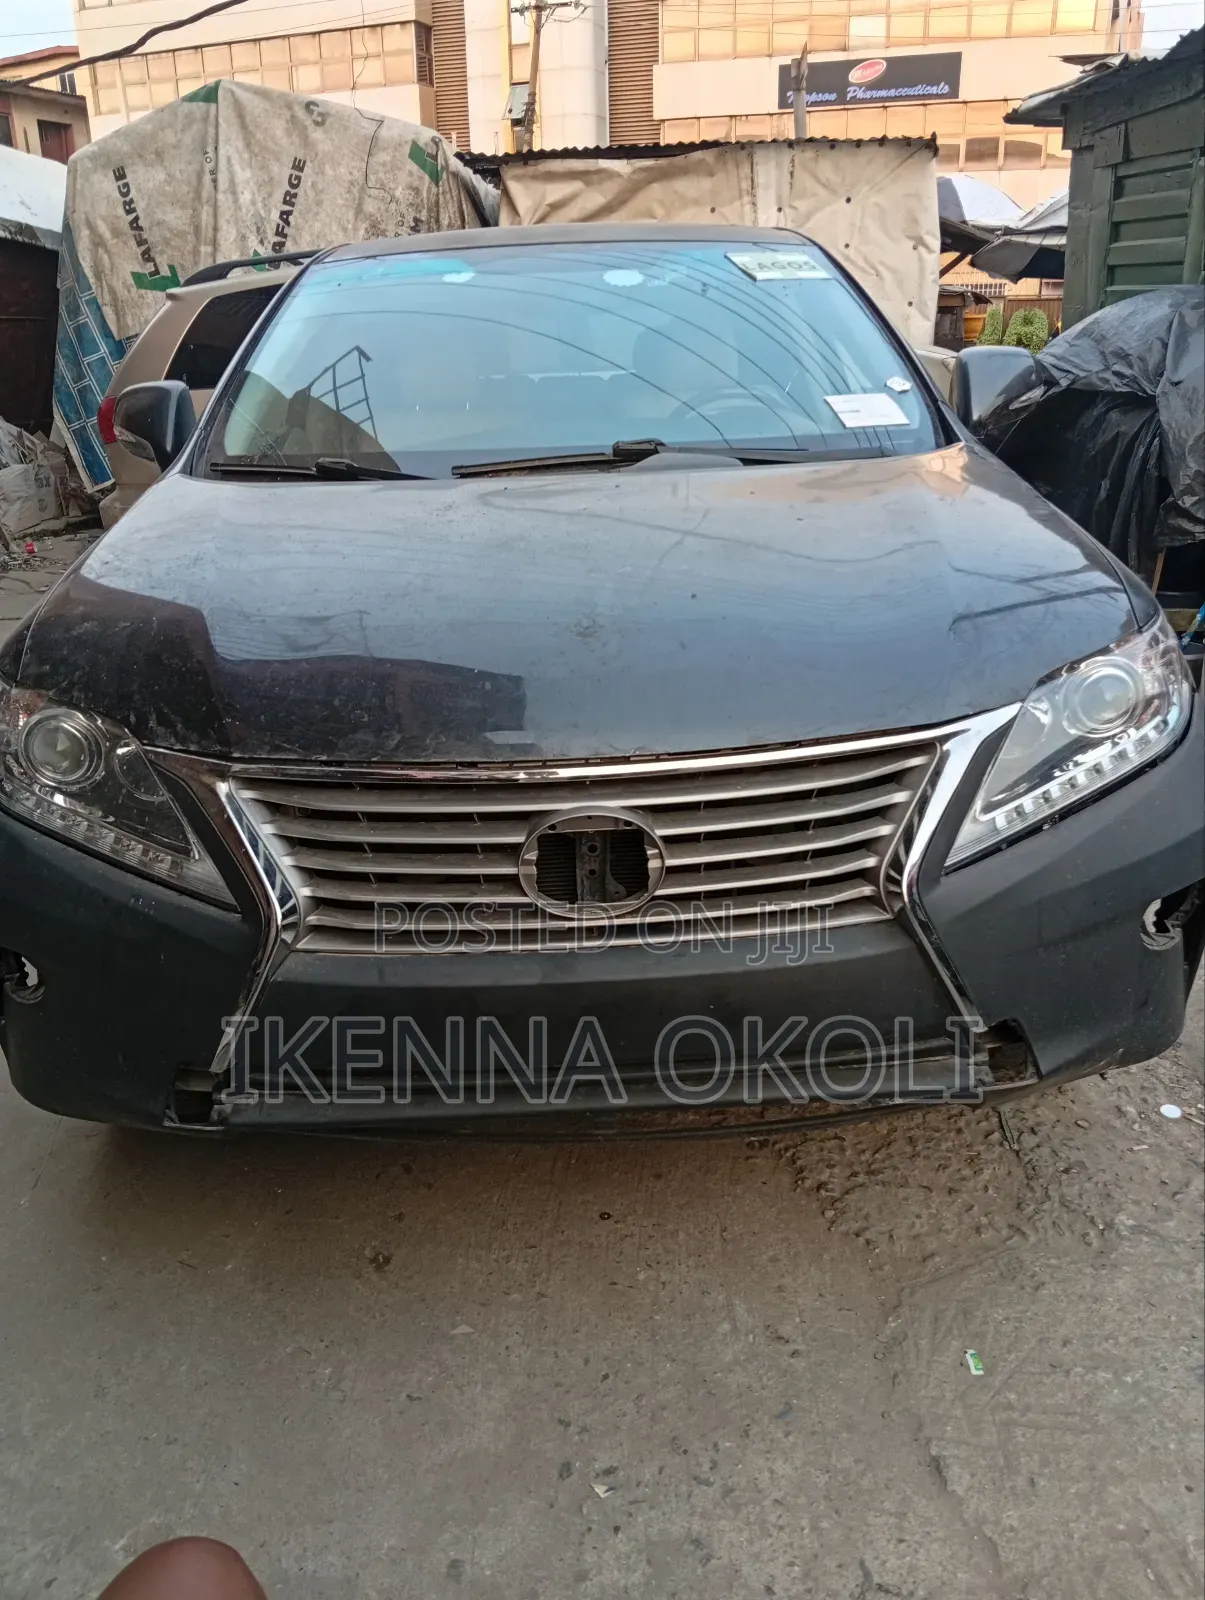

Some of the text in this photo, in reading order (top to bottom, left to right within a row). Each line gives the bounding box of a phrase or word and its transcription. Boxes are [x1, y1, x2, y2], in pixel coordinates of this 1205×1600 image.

[846, 81, 949, 101] Pharmaceuticals
[112, 165, 161, 278] LAFARGE
[742, 261, 817, 271] LAGOS
